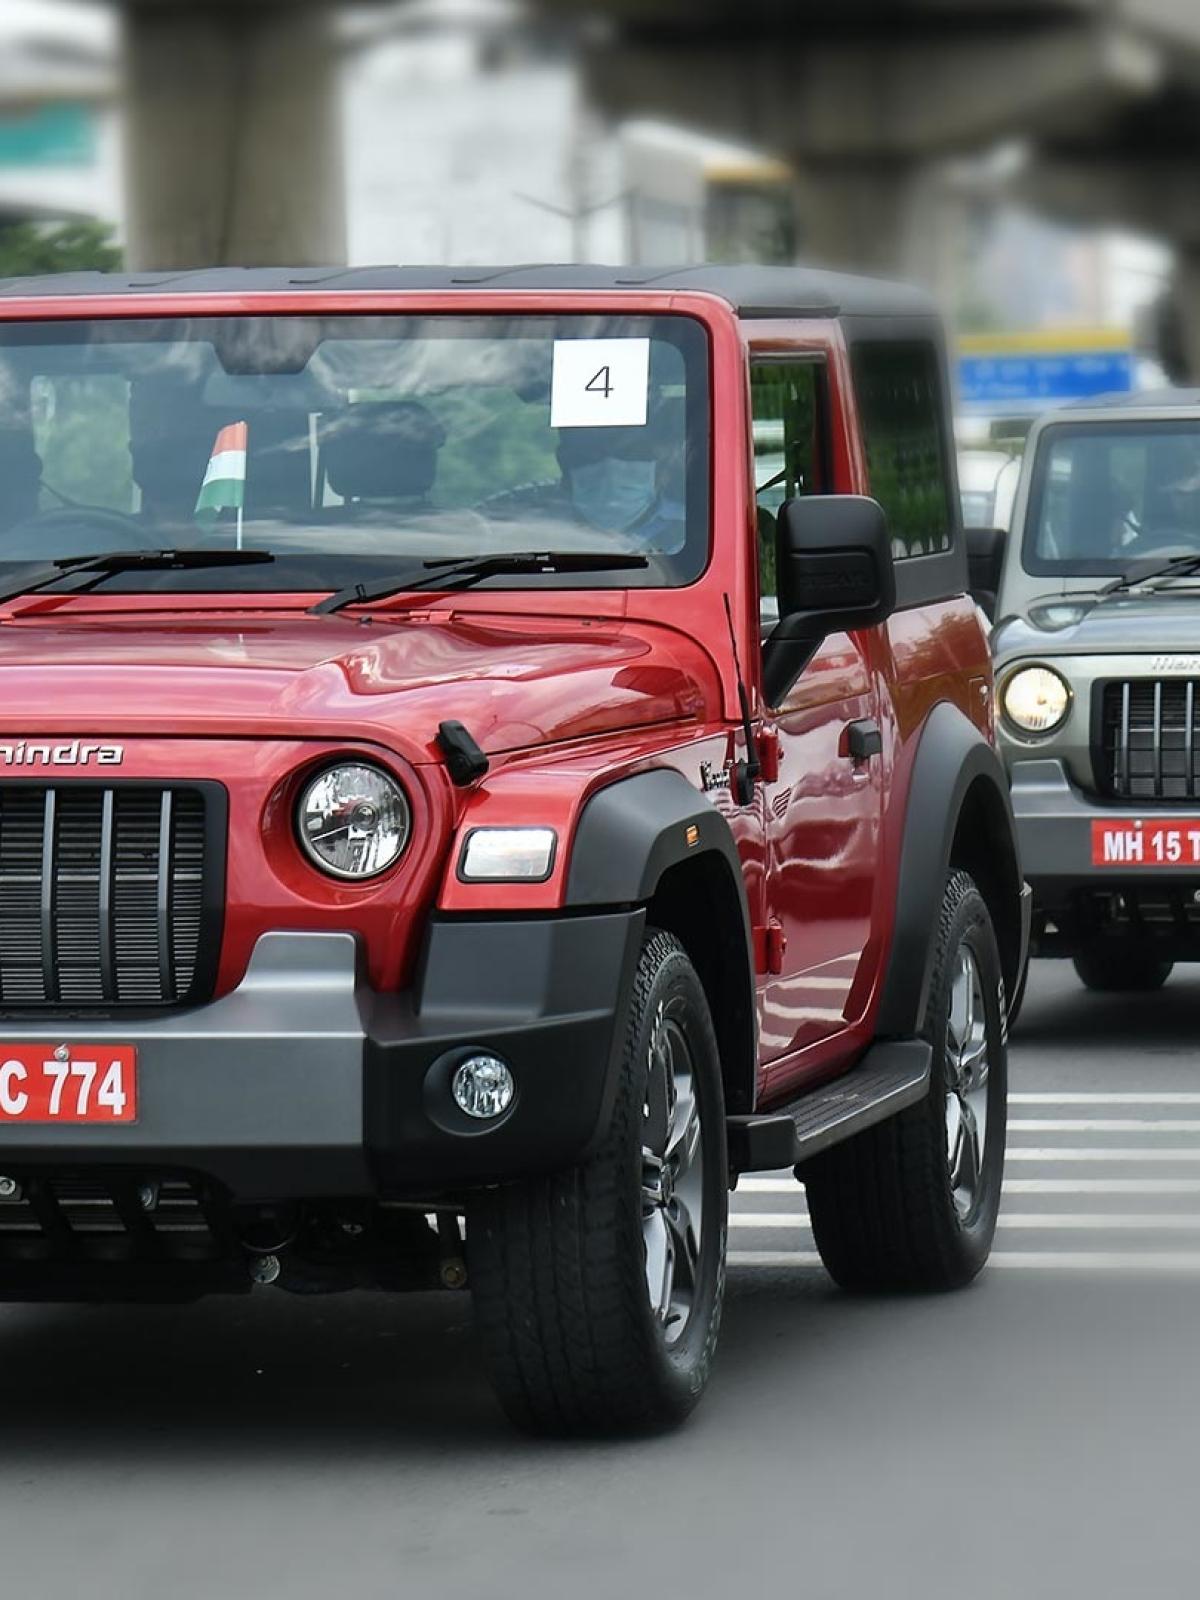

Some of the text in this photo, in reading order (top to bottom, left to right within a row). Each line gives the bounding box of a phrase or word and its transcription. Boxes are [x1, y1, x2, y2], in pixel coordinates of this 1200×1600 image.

[584, 365, 615, 399] 4
[1103, 830, 1200, 862] MH 15 T
[0, 1060, 127, 1115] C 774
